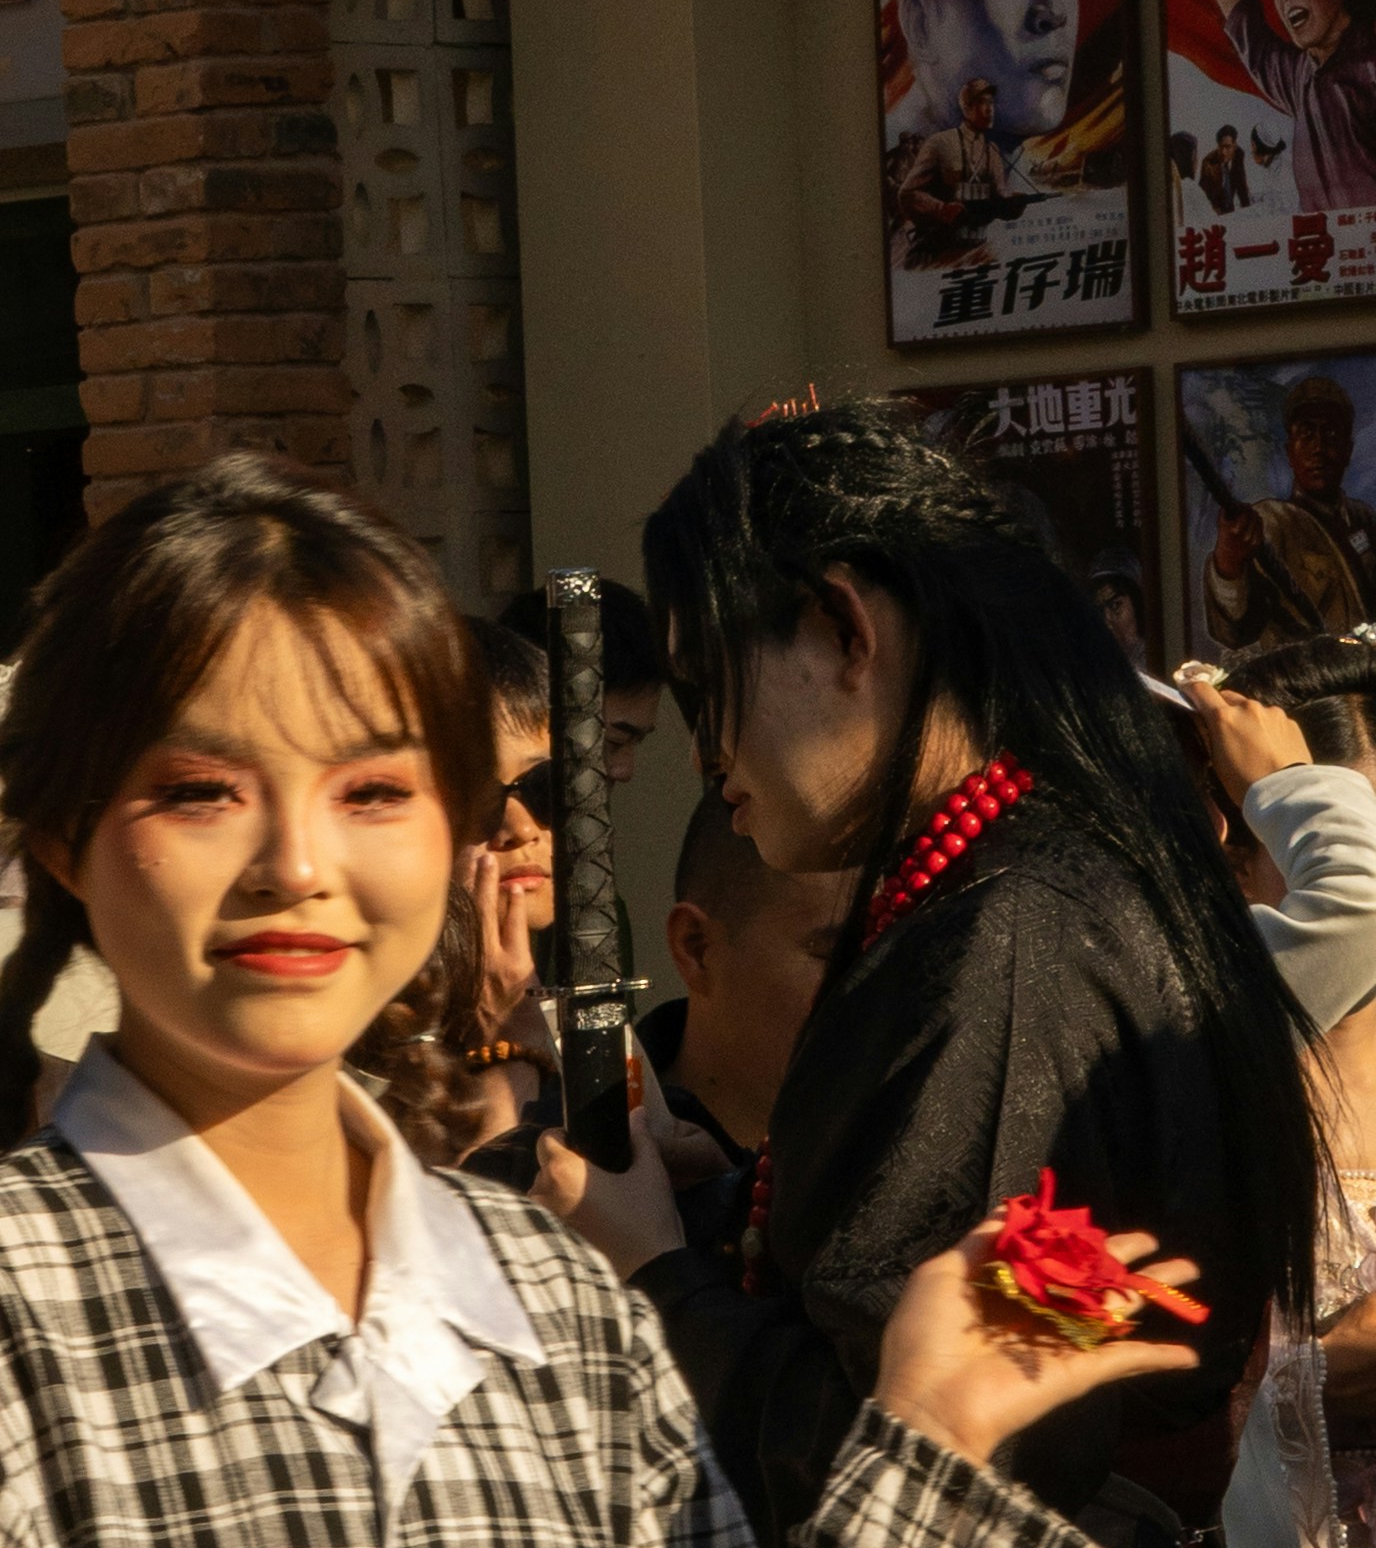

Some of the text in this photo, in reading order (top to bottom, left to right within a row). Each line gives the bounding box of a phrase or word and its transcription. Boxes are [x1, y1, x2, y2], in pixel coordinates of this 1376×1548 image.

[932, 238, 1128, 329] 董存瑞
[988, 375, 1137, 438] 大地重光
